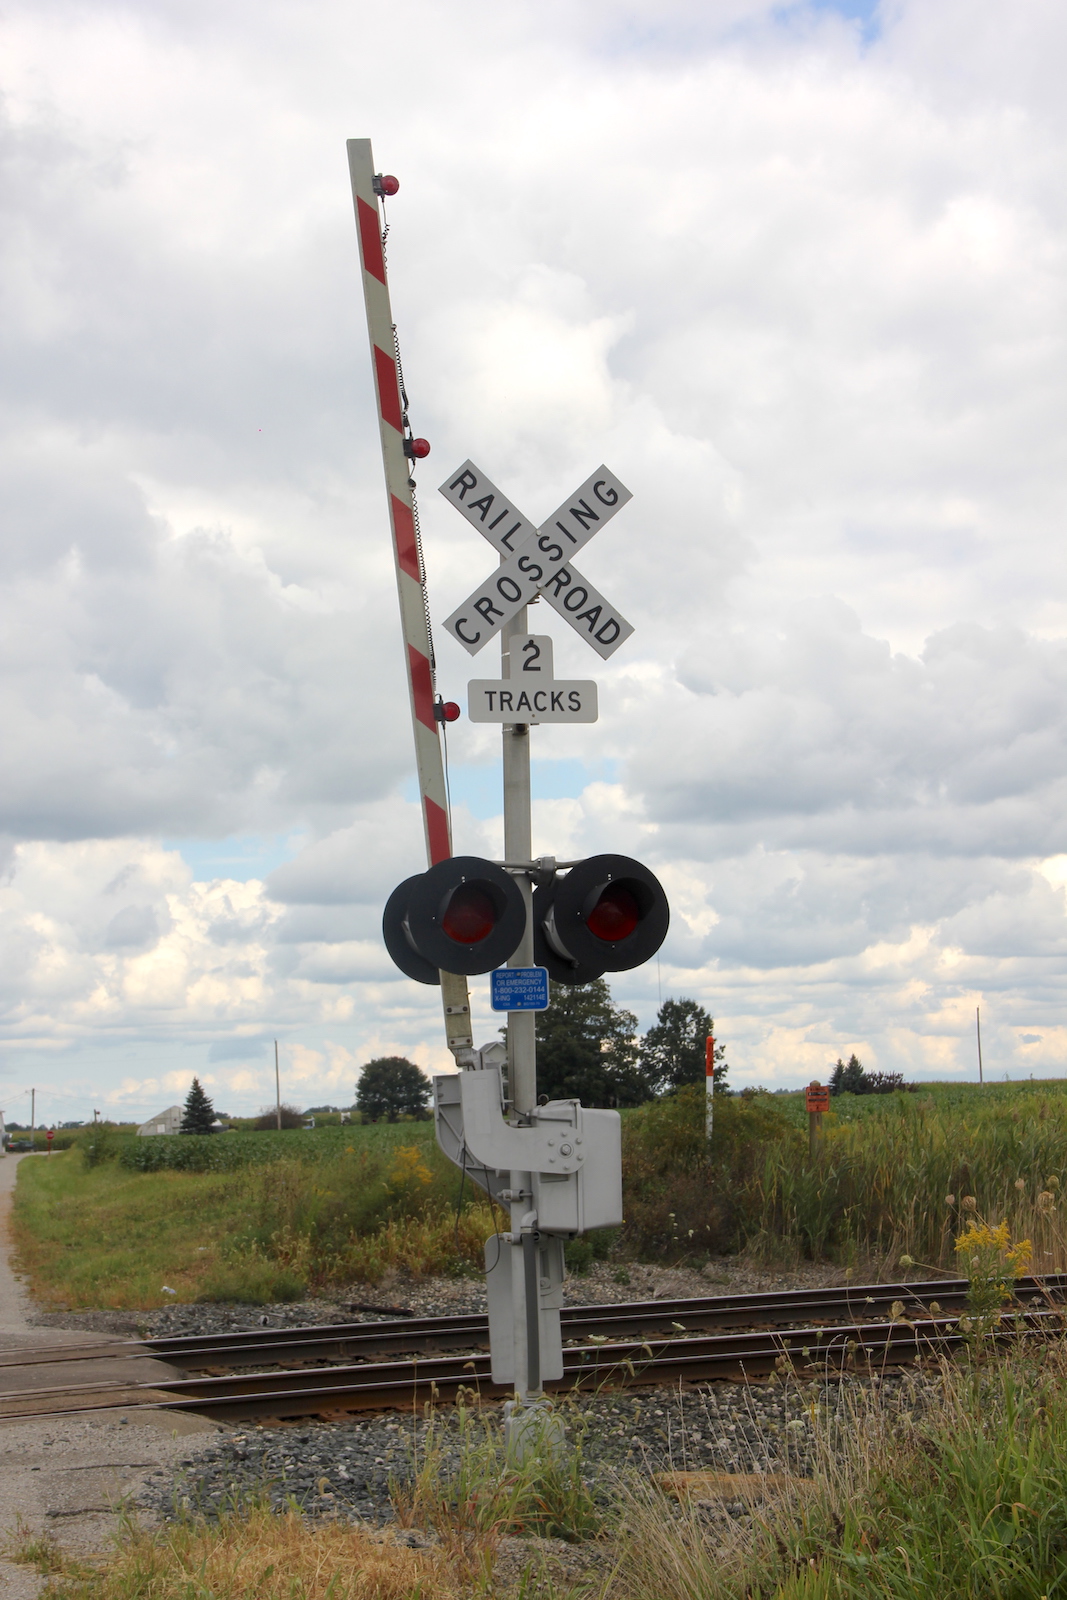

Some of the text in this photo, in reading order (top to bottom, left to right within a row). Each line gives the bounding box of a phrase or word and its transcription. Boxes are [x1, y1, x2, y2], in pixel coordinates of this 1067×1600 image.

[449, 468, 620, 645] RAIL ROAD
[454, 480, 619, 645] CROSSING
[522, 641, 541, 671] 2
[484, 691, 581, 712] TRACKS
[494, 986, 545, 994] 1-800-232-0144
